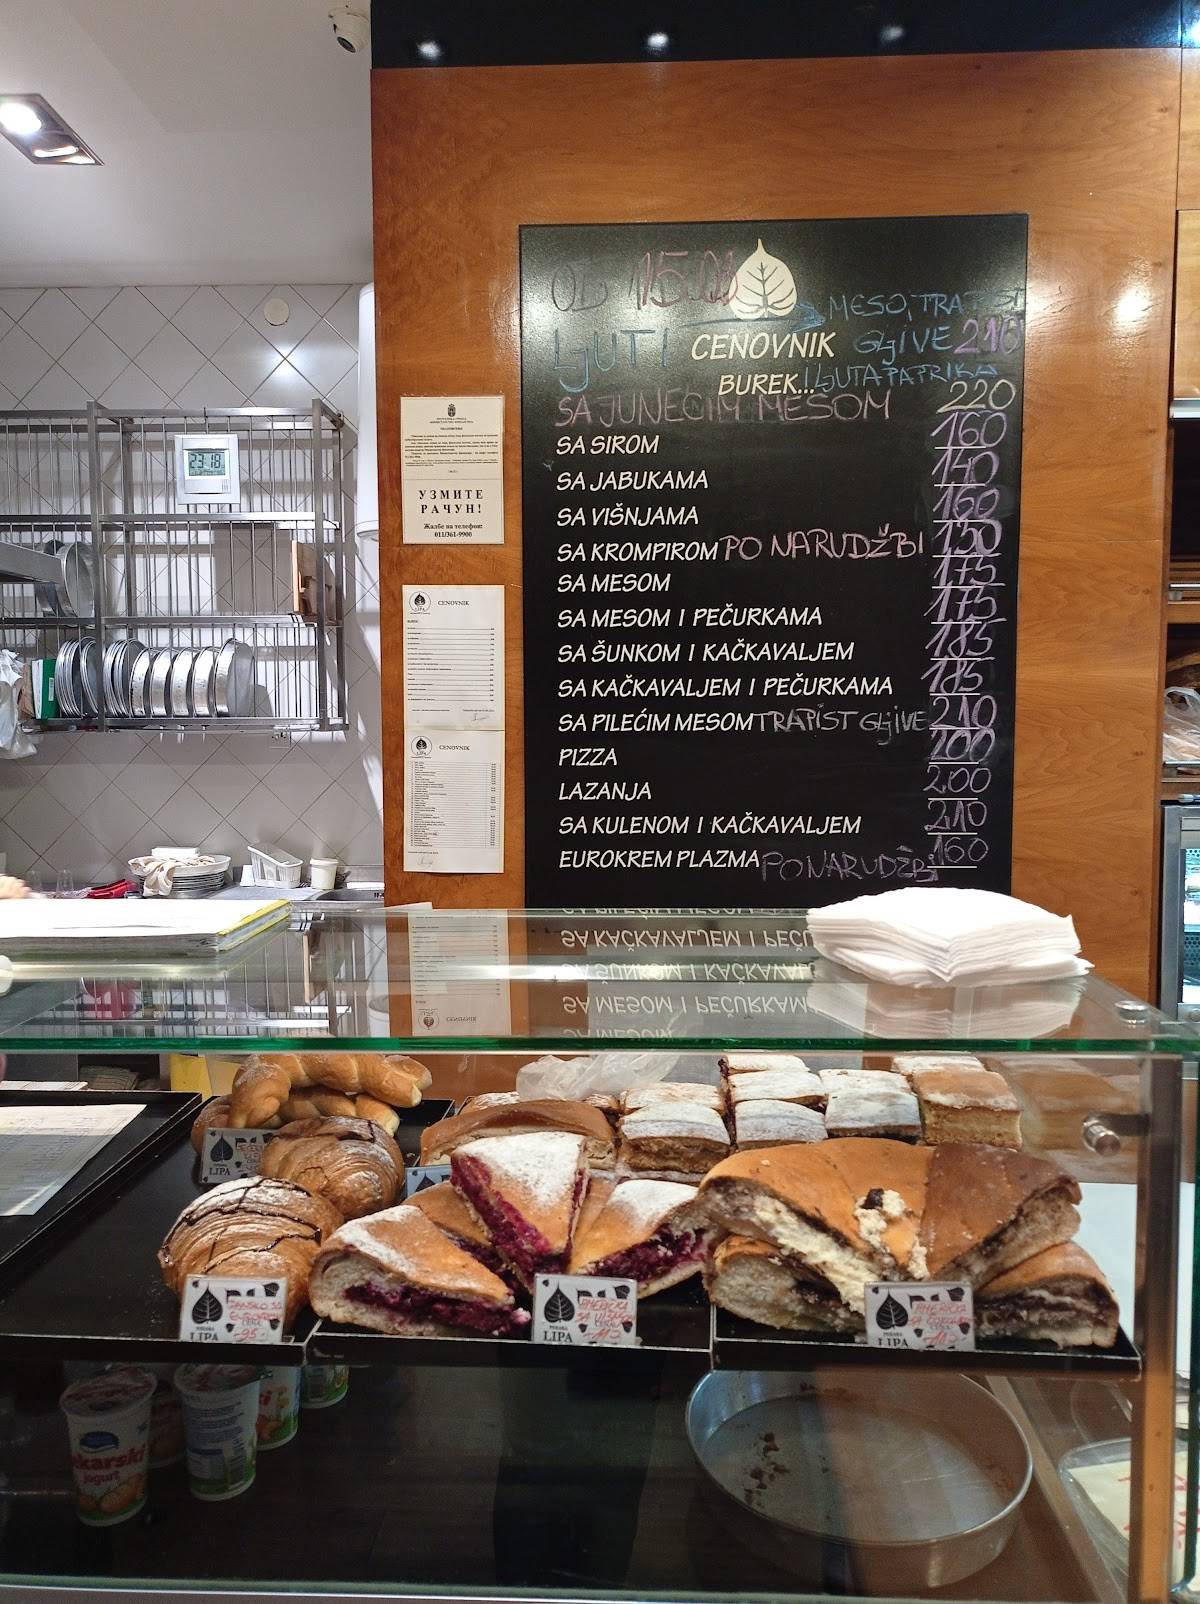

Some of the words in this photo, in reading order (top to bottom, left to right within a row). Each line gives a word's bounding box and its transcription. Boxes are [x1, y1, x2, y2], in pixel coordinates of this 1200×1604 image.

[691, 332, 835, 360] CENOVNIK
[758, 388, 892, 426] MESOM
[936, 378, 1017, 415] 220
[930, 410, 1008, 449] 160
[556, 436, 586, 455] SA
[590, 435, 660, 455] SIROM
[556, 472, 586, 491] SA
[590, 470, 709, 491] JABUKAMA
[419, 490, 484, 500] УЗМИТЕ
[421, 504, 482, 514] РАЧУН!
[556, 508, 587, 527] SA
[591, 502, 700, 526] VIŠNJAMA
[557, 543, 587, 562] SA
[591, 542, 719, 562] KROMPIROM
[719, 535, 763, 561] PO
[771, 523, 924, 560] NARUDŽBI
[557, 574, 586, 593] SA
[591, 573, 671, 592] MESOM
[557, 609, 587, 628] SA
[591, 608, 671, 627] MESOM
[678, 608, 685, 627] I
[692, 603, 823, 627] PEČURKAMA
[557, 644, 587, 664] SA
[591, 640, 681, 663] ŠUNKOM
[687, 644, 695, 662] I
[702, 638, 855, 662] KAČKAVALJEM
[557, 679, 587, 698] SA
[591, 675, 741, 698] KAČKAVALJEM
[748, 678, 755, 696] I
[762, 673, 893, 697] PEČURKAMA
[557, 714, 587, 733] SA
[592, 708, 670, 732] PILEĆIM
[674, 712, 754, 732] MESOM
[929, 694, 998, 730] 210
[559, 748, 618, 766] PIZZA
[559, 782, 652, 801] LAZANJA
[559, 816, 587, 835] SA
[592, 816, 689, 835] KULENOM
[697, 816, 703, 834] I
[710, 811, 862, 835] KAČKAVALJEM
[559, 850, 671, 868] EUROKREM
[676, 850, 760, 869] PLAZMA
[761, 851, 803, 881] PO
[209, 1168, 230, 1176] LIPA
[544, 1331, 573, 1343] LIPA
